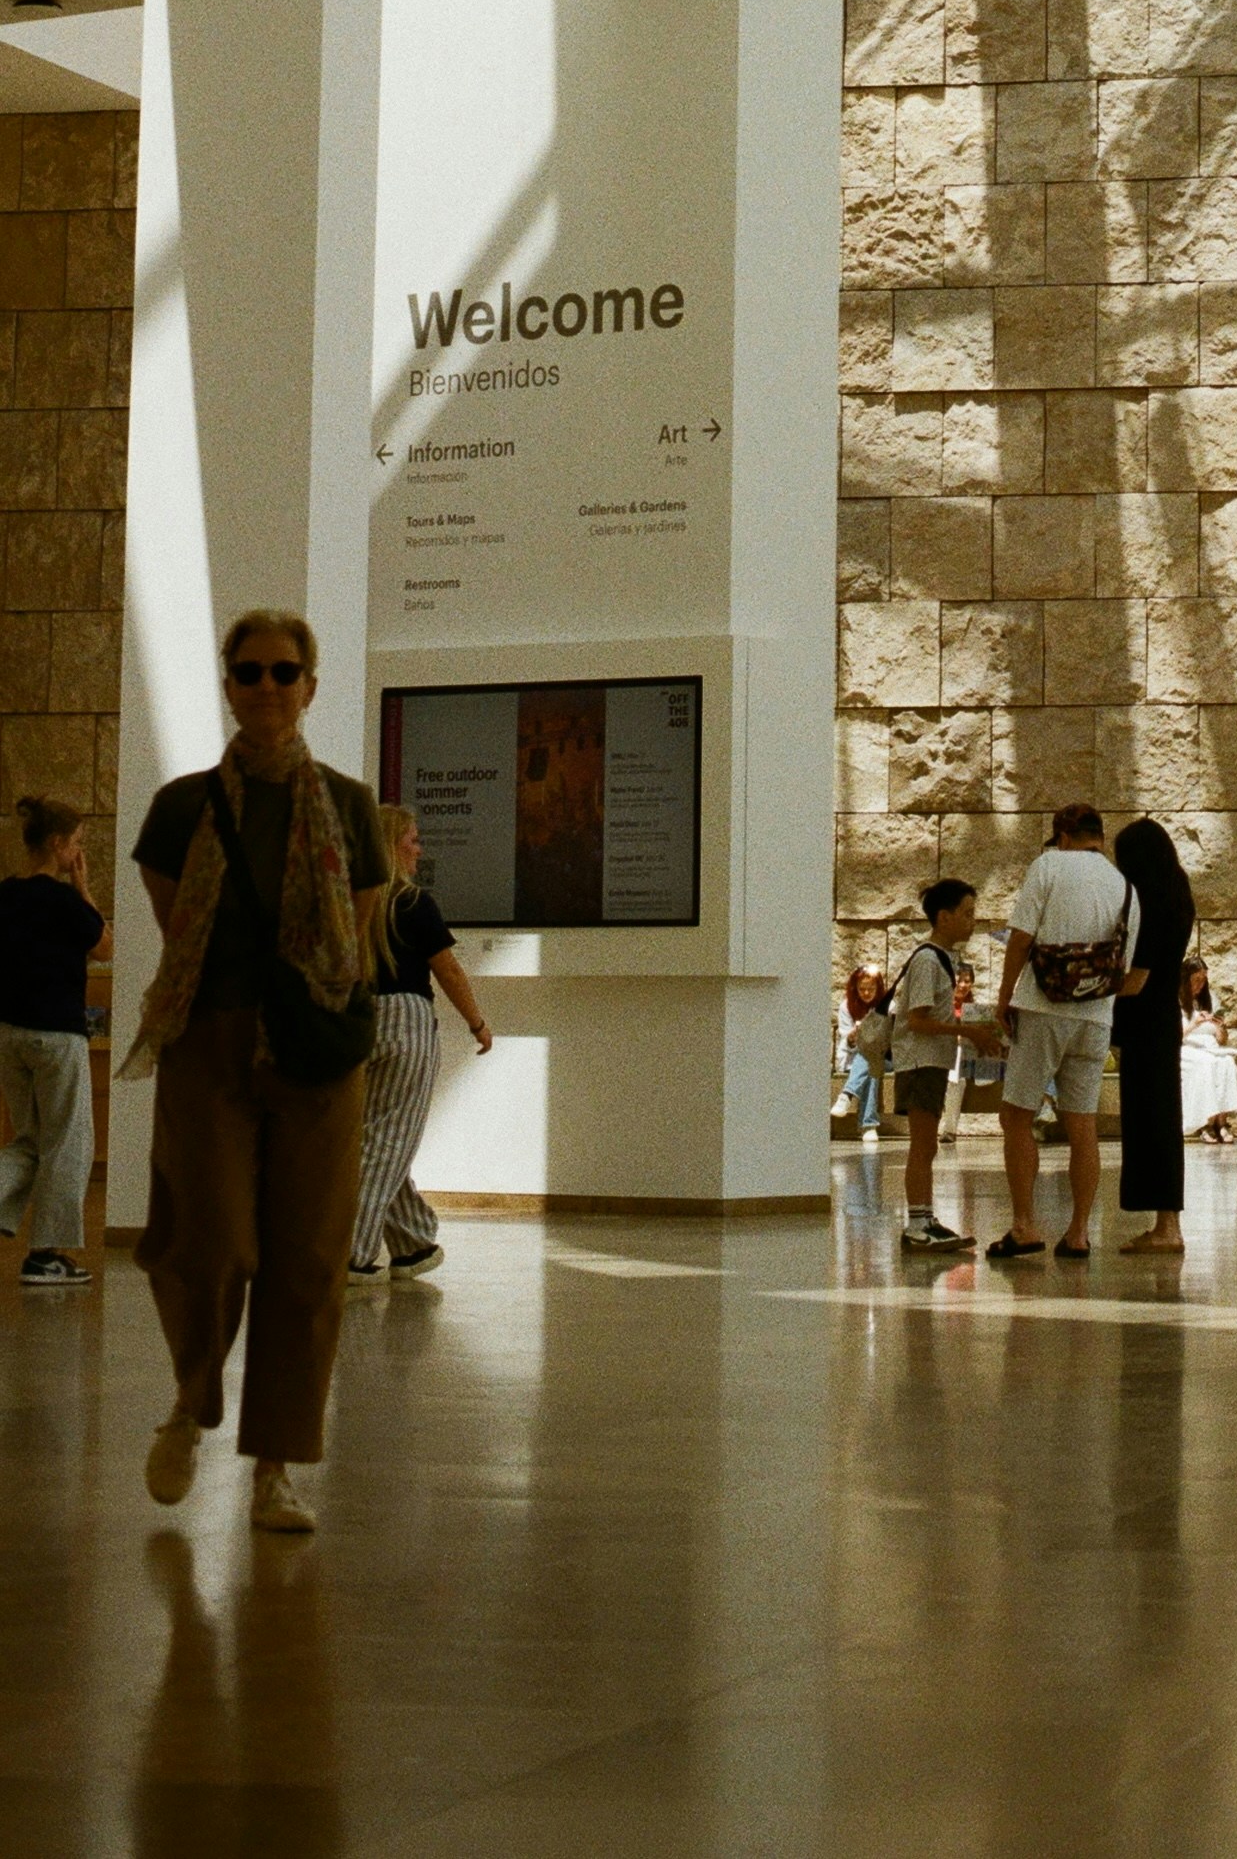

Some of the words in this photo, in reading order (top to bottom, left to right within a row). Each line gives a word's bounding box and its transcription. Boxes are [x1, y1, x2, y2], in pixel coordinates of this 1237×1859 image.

[407, 282, 685, 350] Welcome
[409, 359, 561, 397] Bienvenidos
[657, 424, 688, 445] Art
[407, 437, 516, 464] Information
[664, 454, 688, 468] Arte
[578, 502, 627, 517] Galleries
[629, 501, 638, 514] &
[639, 500, 687, 514] Gardens
[405, 516, 435, 529] Tours
[436, 514, 445, 527] &
[446, 514, 476, 528] Maps
[404, 579, 461, 591] Restrooms
[668, 693, 690, 705] OFF
[668, 705, 690, 716] THE
[415, 767, 445, 783] Free
[446, 766, 499, 782] outdoor
[415, 786, 469, 800] summer
[418, 802, 473, 816] oncerts
